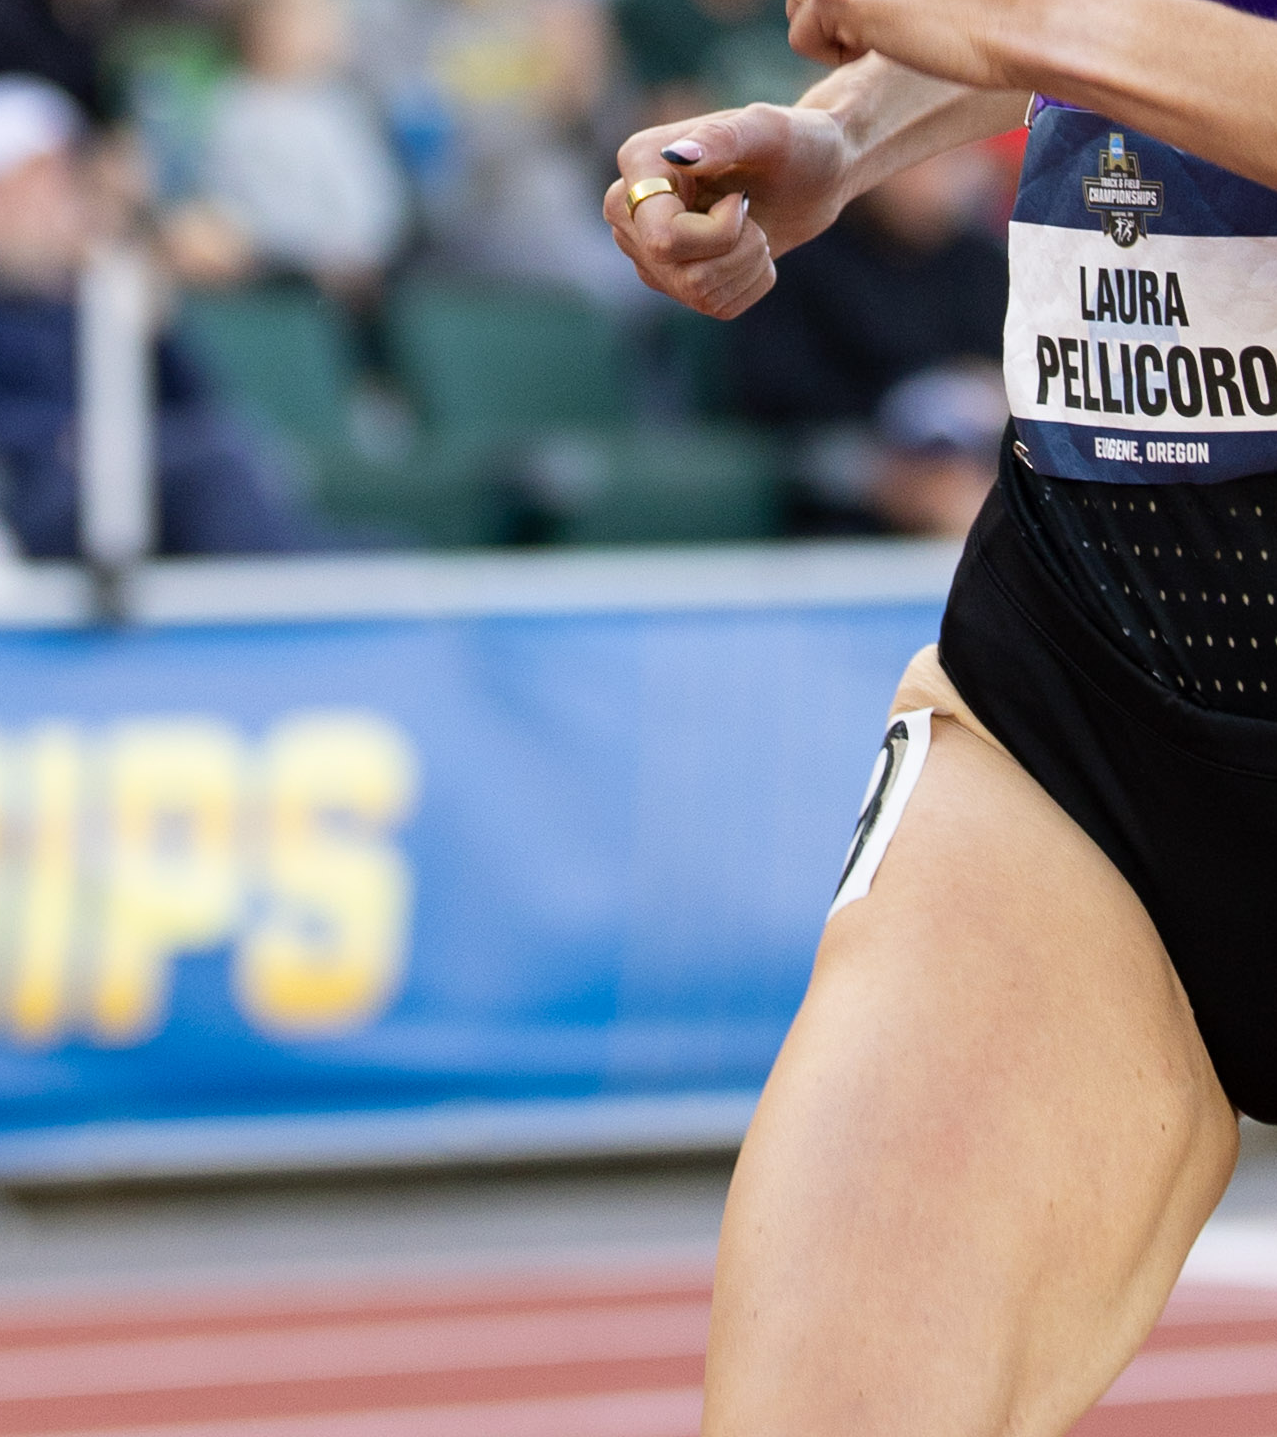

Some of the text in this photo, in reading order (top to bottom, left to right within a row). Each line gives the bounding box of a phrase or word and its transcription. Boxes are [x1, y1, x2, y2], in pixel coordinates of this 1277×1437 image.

[1088, 187, 1157, 206] CHAMPIONSHIPS
[1079, 265, 1190, 327] LAURA
[1094, 436, 1210, 464] EUGENE, OREGON
